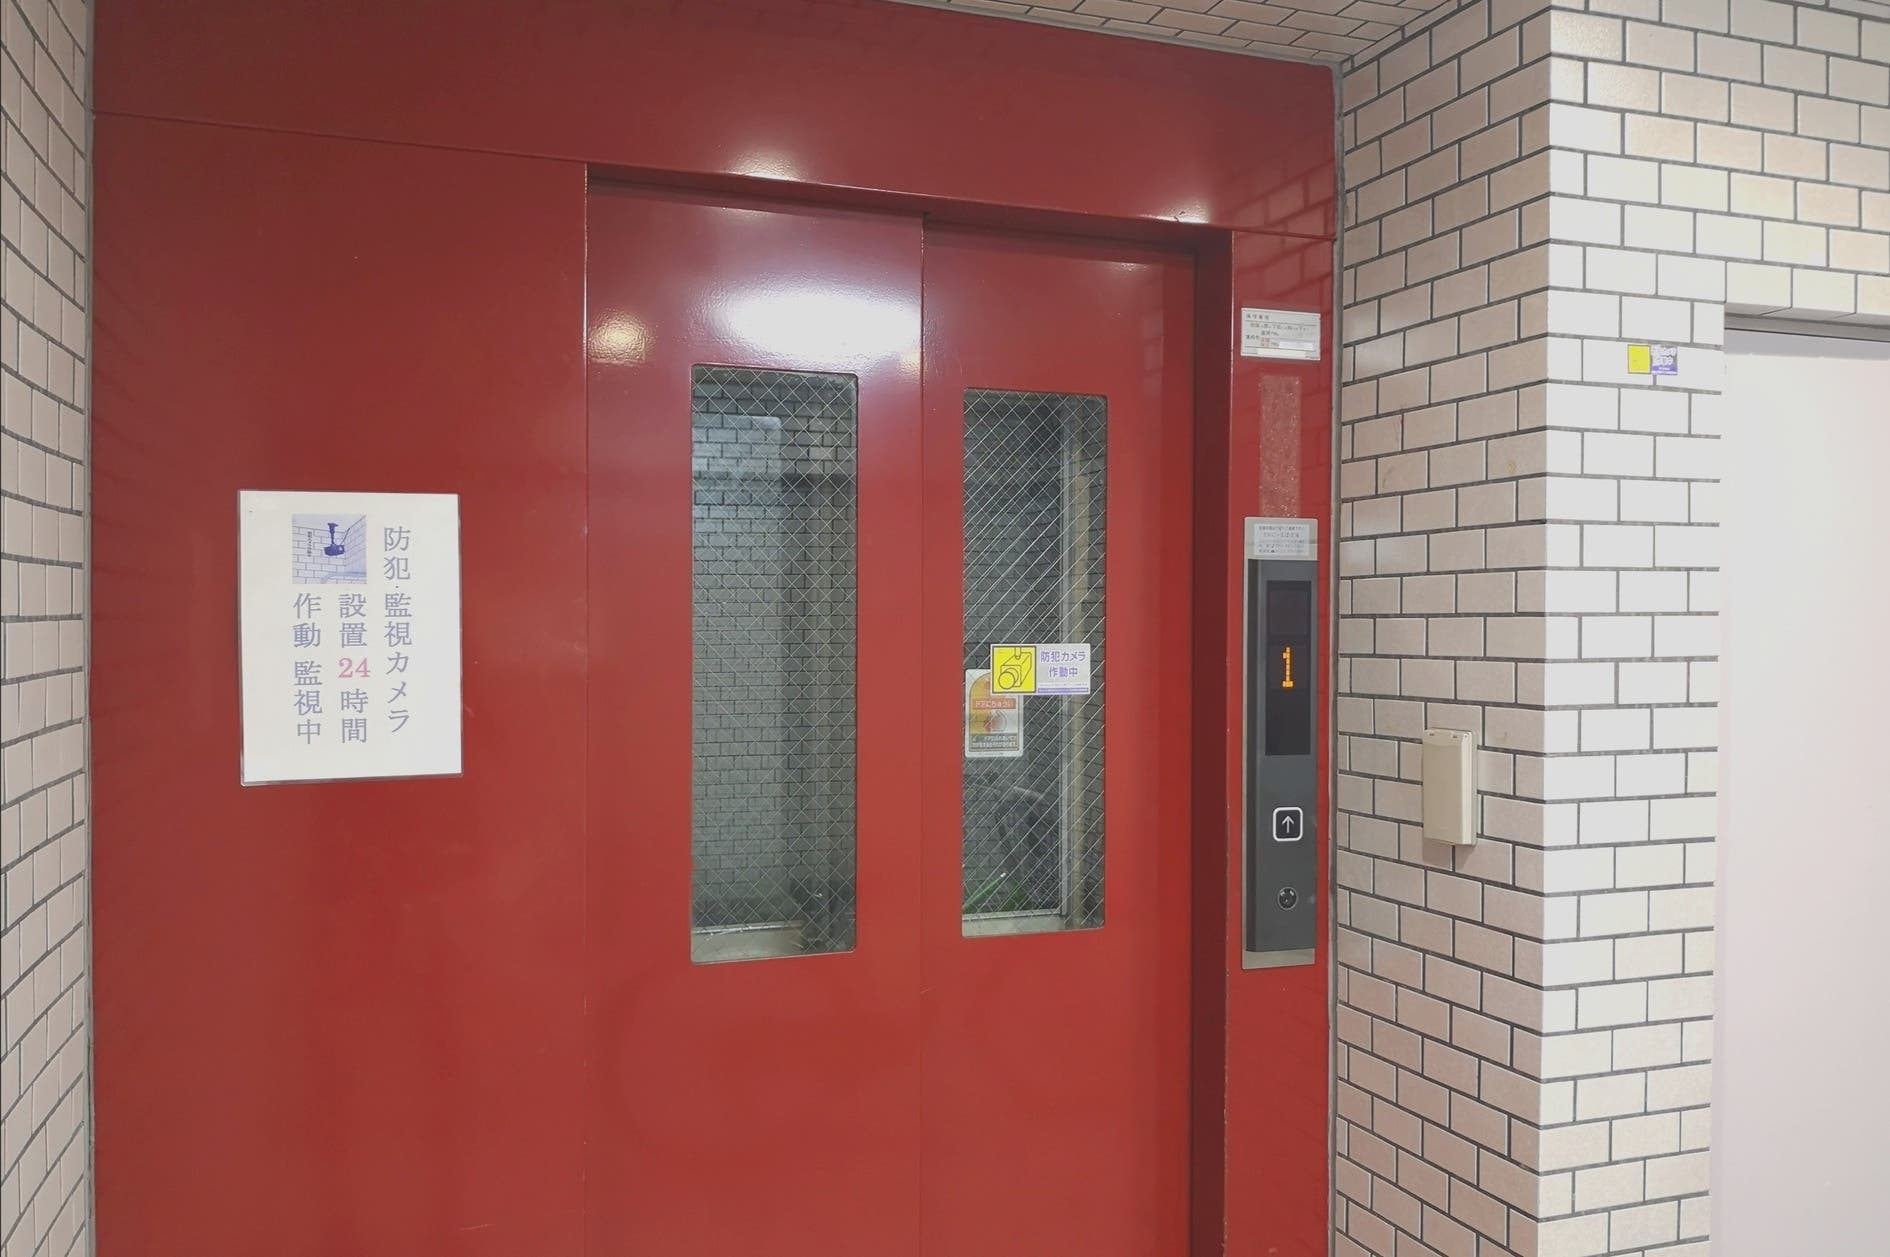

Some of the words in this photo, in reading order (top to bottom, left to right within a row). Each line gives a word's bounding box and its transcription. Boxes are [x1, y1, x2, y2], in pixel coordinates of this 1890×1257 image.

[338, 593, 371, 743] 設置24時間
[1040, 651, 1086, 662] 防犯カメラ
[1282, 646, 1294, 689] 1
[1049, 666, 1078, 677] 作動中
